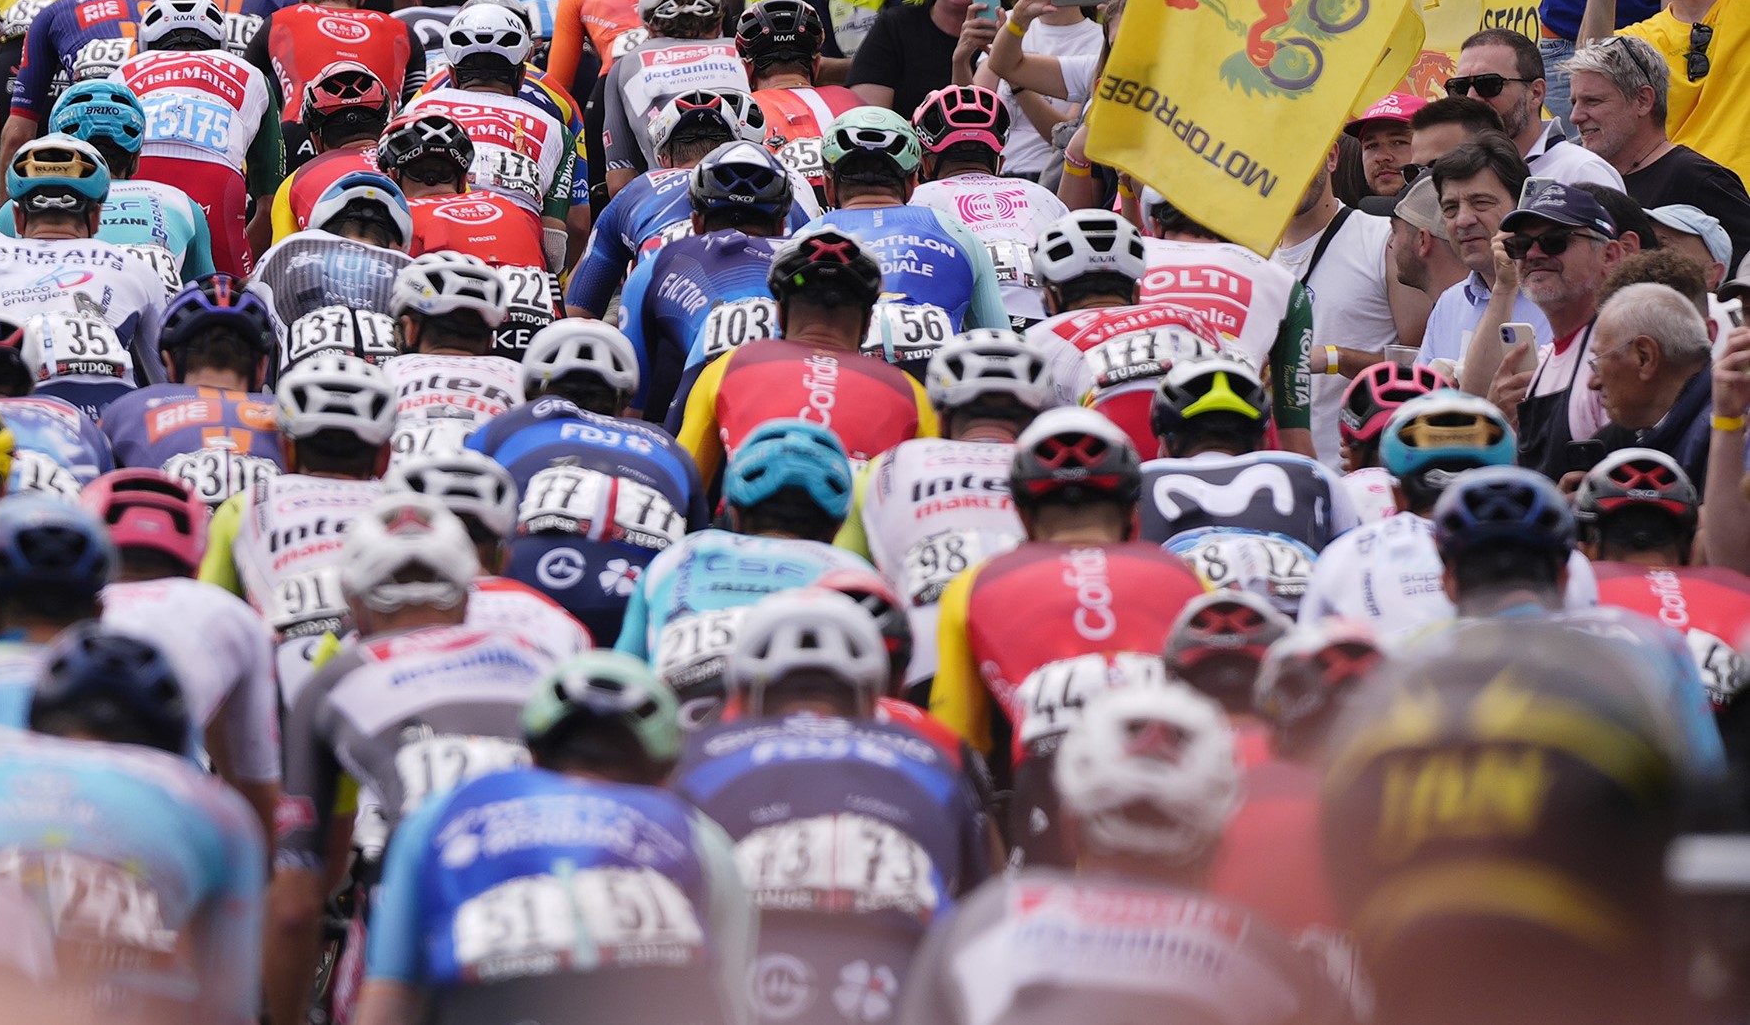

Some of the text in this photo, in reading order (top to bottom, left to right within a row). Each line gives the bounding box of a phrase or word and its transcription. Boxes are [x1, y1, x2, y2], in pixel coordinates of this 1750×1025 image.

[173, 14, 196, 22] KASK
[228, 17, 256, 44] 16
[773, 33, 796, 42] KASK
[78, 40, 126, 64] 165
[653, 46, 727, 64] Alpecin
[133, 66, 237, 100] VisitMalta
[84, 106, 120, 117] BRIKO
[179, 100, 231, 153] 175
[781, 141, 820, 166] 85
[98, 217, 149, 227] IZANE
[967, 220, 1019, 234] ducation
[334, 254, 394, 278] UB
[882, 262, 934, 278] DIALE
[1, 285, 51, 299] Bapco
[2, 290, 70, 308] energies
[508, 272, 549, 309] 22
[657, 272, 708, 315] FACTOR
[65, 317, 109, 357] 35
[707, 305, 771, 353] 103
[900, 309, 944, 342] 56
[68, 362, 116, 376] TUDOR
[1294, 328, 1311, 408] KOMETA
[560, 422, 620, 448] FDJ
[917, 538, 968, 575] 98
